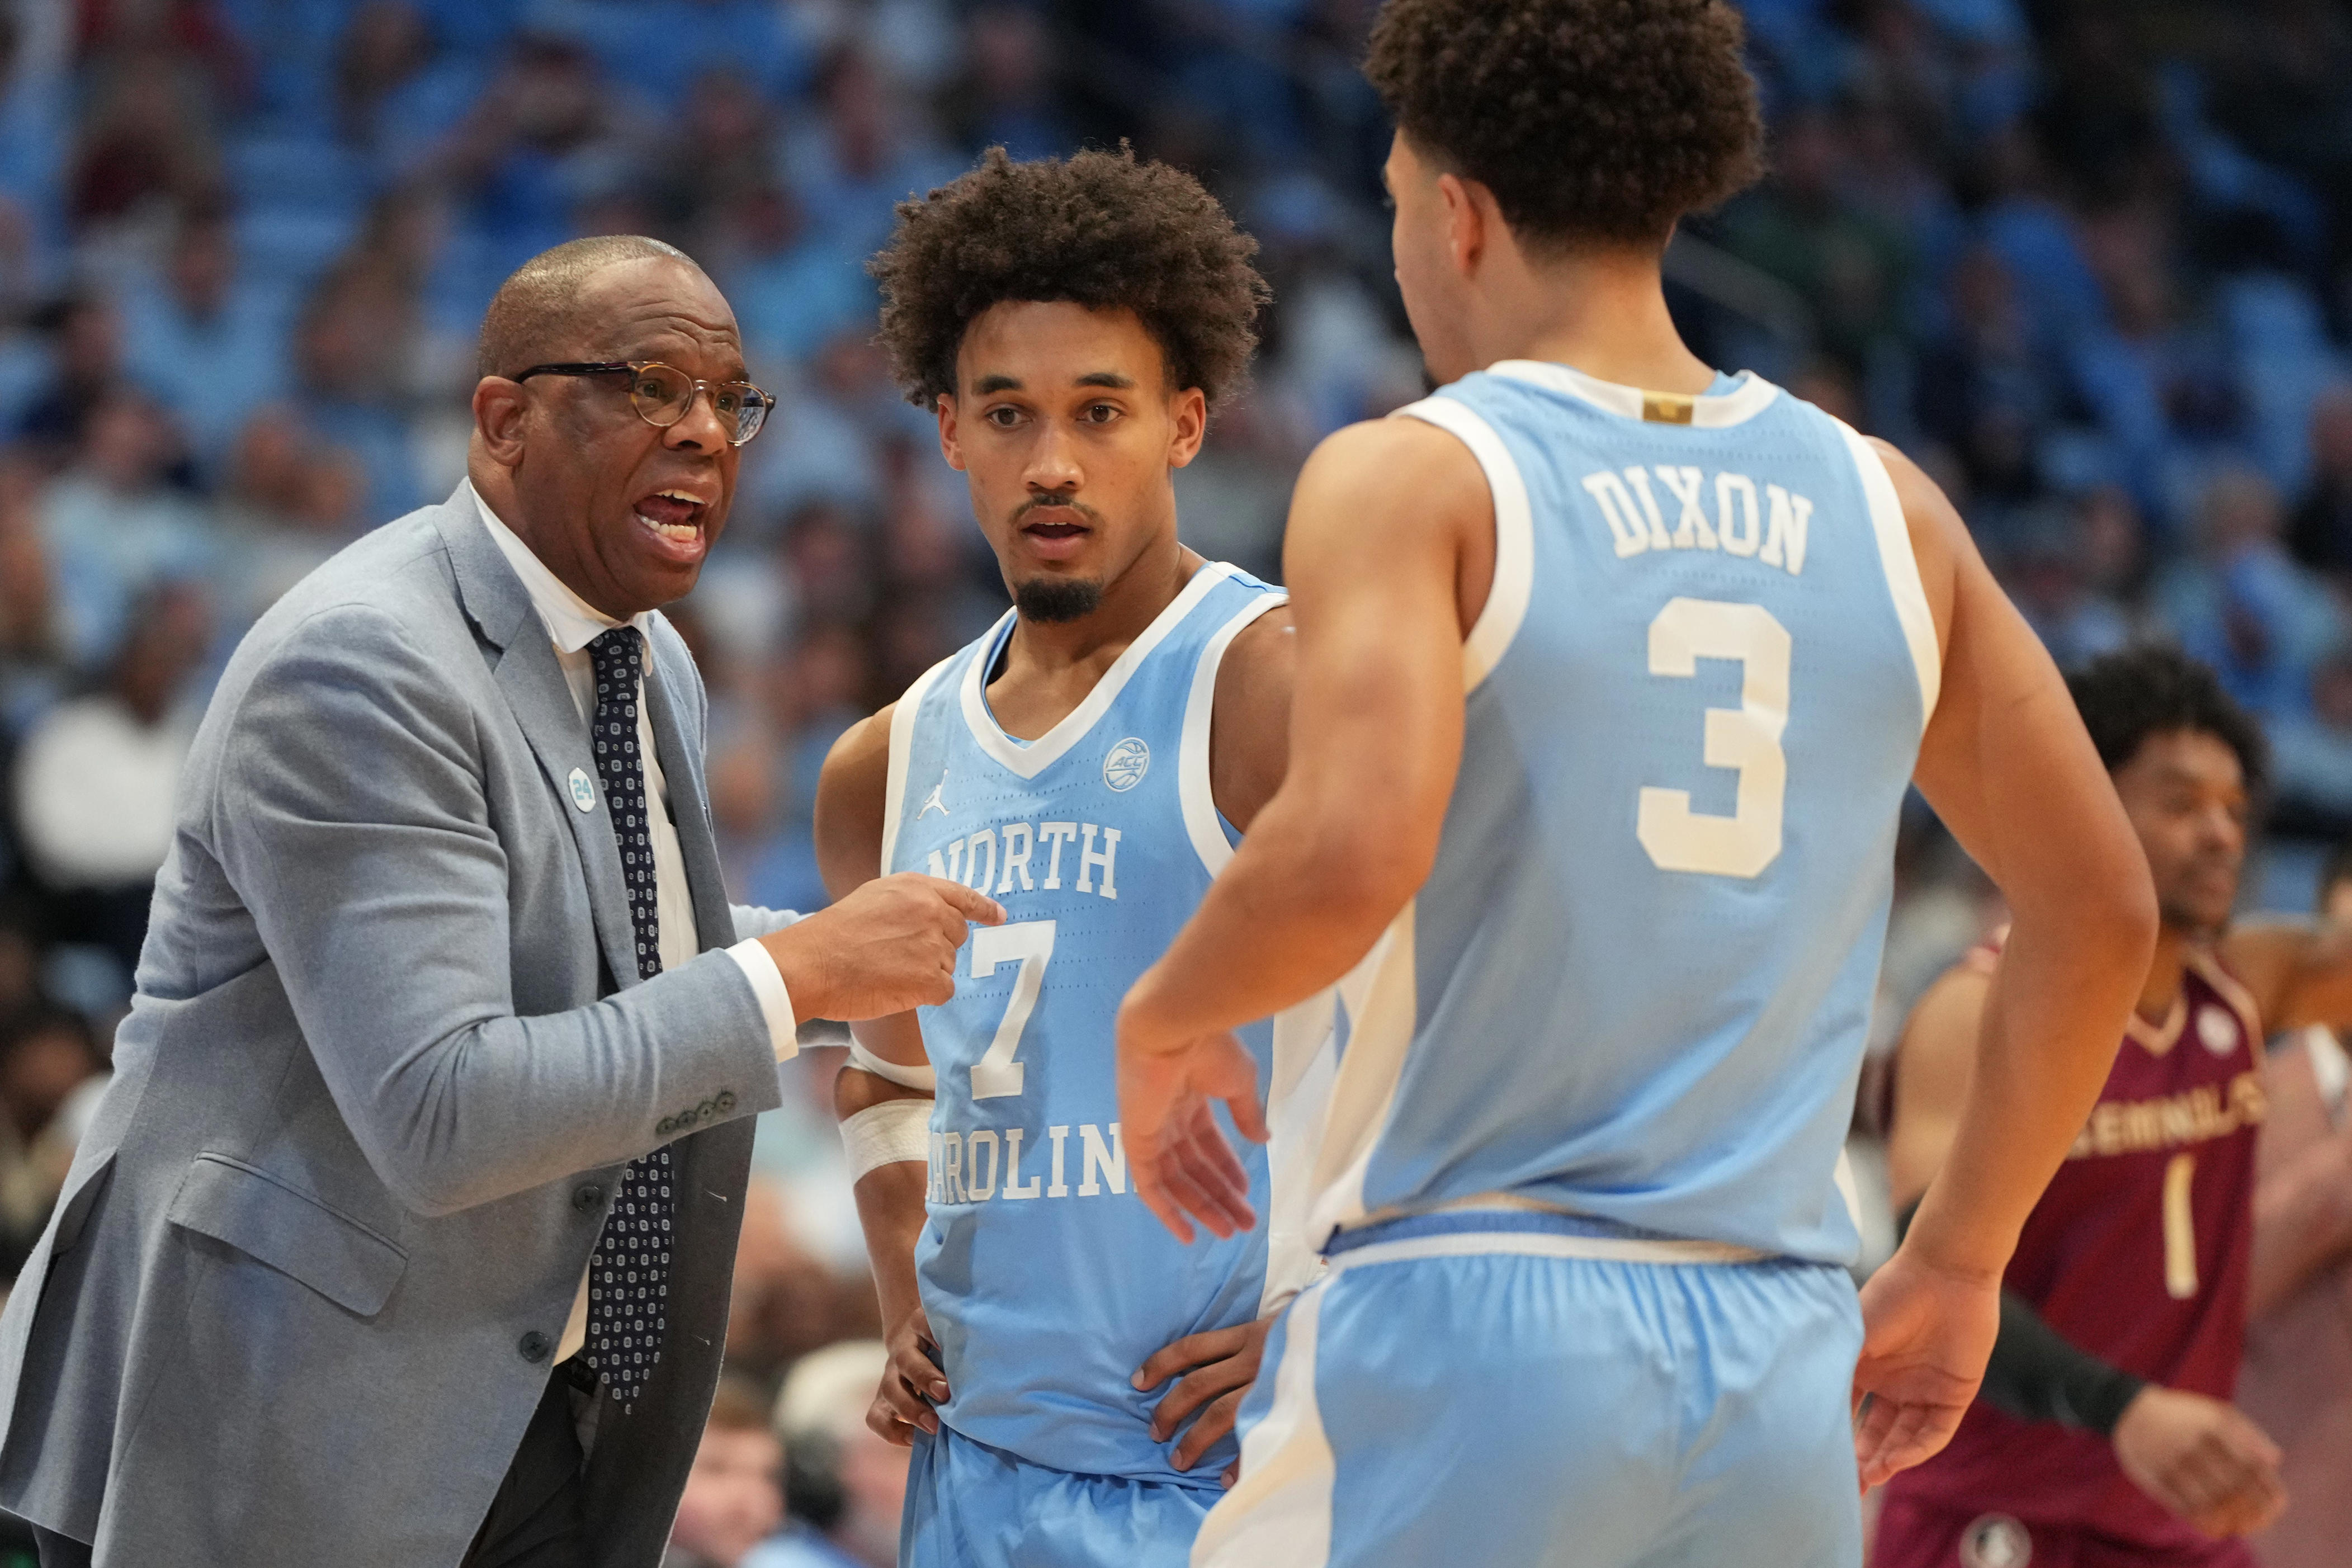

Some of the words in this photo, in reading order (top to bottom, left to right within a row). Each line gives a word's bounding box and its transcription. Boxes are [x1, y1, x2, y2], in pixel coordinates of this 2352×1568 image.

[1582, 464, 1813, 576] DIXON
[1111, 755, 1144, 767] ACC
[1636, 597, 1791, 879] 3
[573, 779, 592, 800] 24
[927, 822, 1121, 900] NORTH
[971, 920, 1056, 1100] 7
[925, 1122, 1138, 1204] AROLIN
[2163, 1154, 2198, 1299] 1
